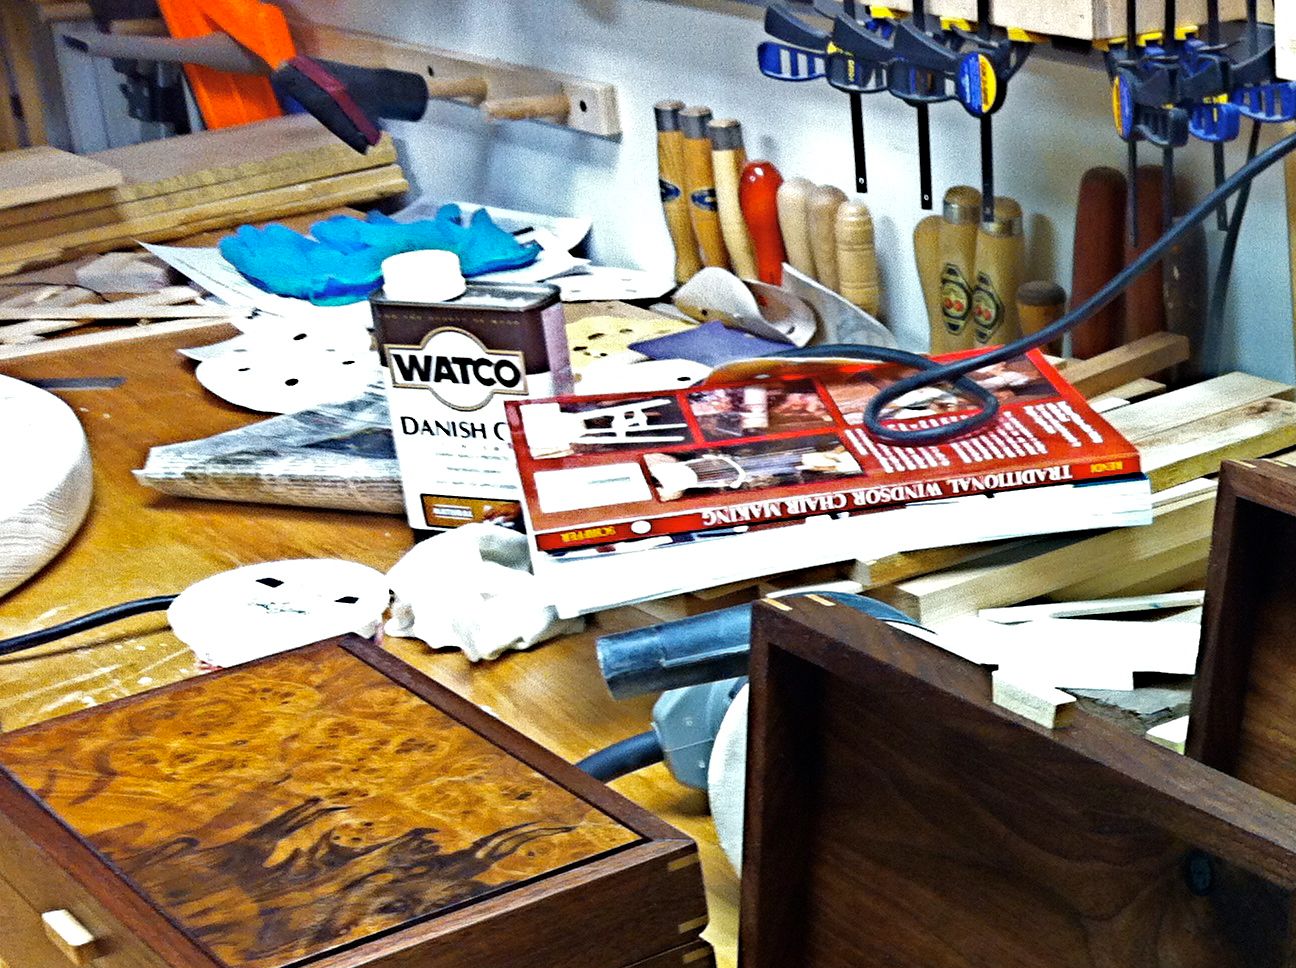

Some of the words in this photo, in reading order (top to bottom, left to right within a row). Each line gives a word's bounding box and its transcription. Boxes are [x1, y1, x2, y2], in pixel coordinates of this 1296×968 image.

[392, 353, 521, 388] WATCO
[400, 416, 487, 440] DANISH
[949, 464, 1073, 494] TRADITIONAL
[786, 492, 848, 515] CHAIR
[853, 482, 943, 506] WINDSOR
[701, 500, 782, 526] MAKING
